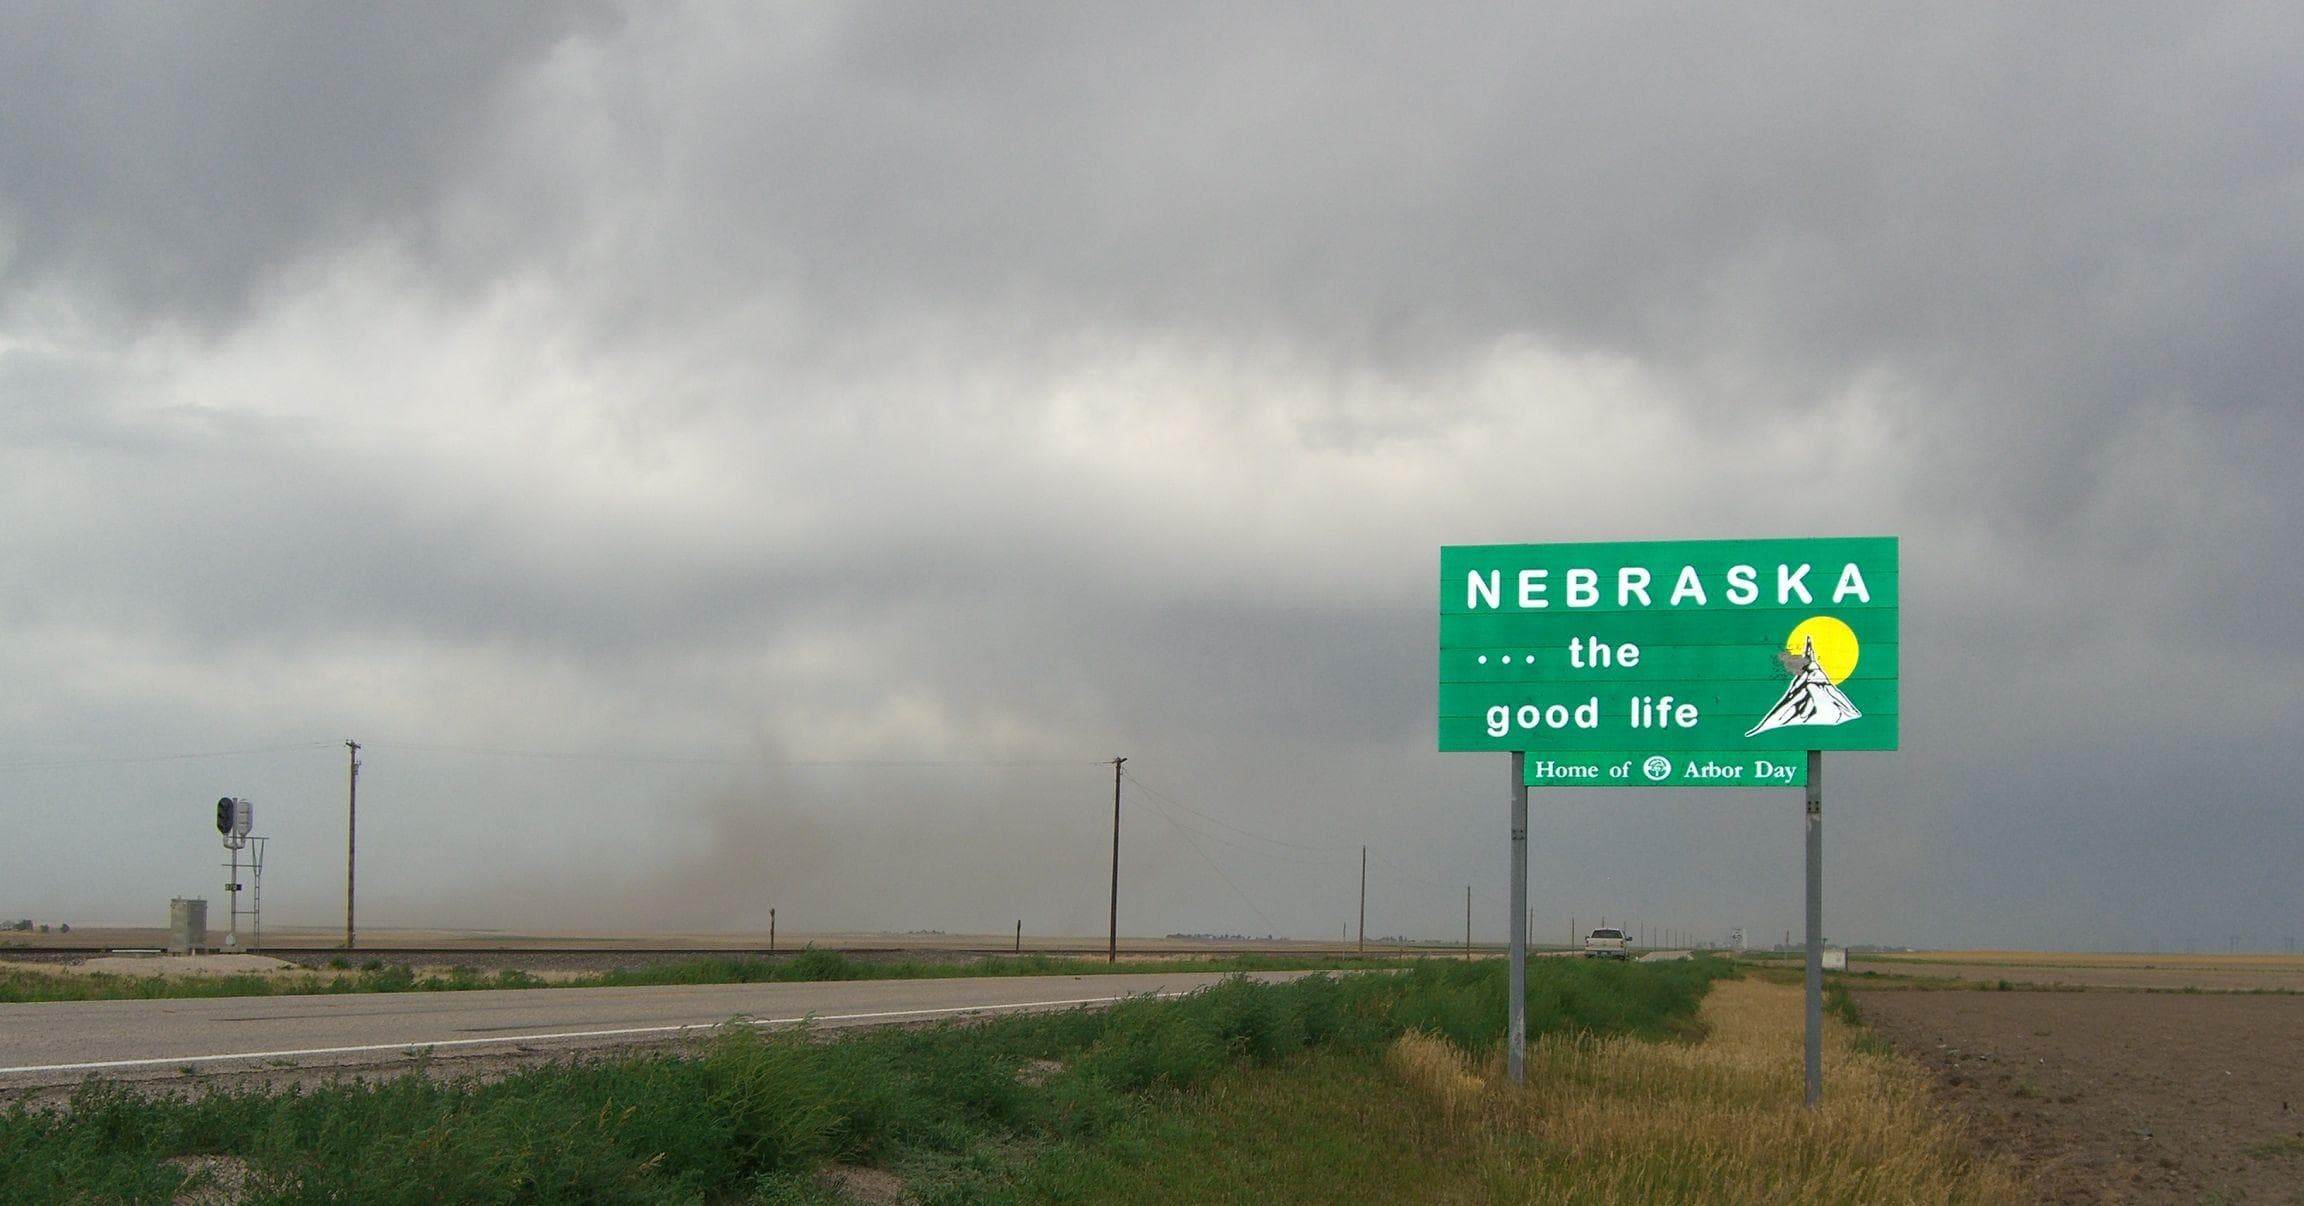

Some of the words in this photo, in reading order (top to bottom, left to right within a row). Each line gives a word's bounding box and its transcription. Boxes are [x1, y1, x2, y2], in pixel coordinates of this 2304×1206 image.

[1466, 562, 1871, 610] NEBRASKA
[1568, 635, 1641, 668] the
[1486, 696, 1599, 738] good
[1630, 695, 1699, 729] life
[1535, 760, 1600, 778] Home
[1609, 760, 1632, 778] of
[1683, 760, 1745, 778] Arbor
[1754, 760, 1797, 784] Day
